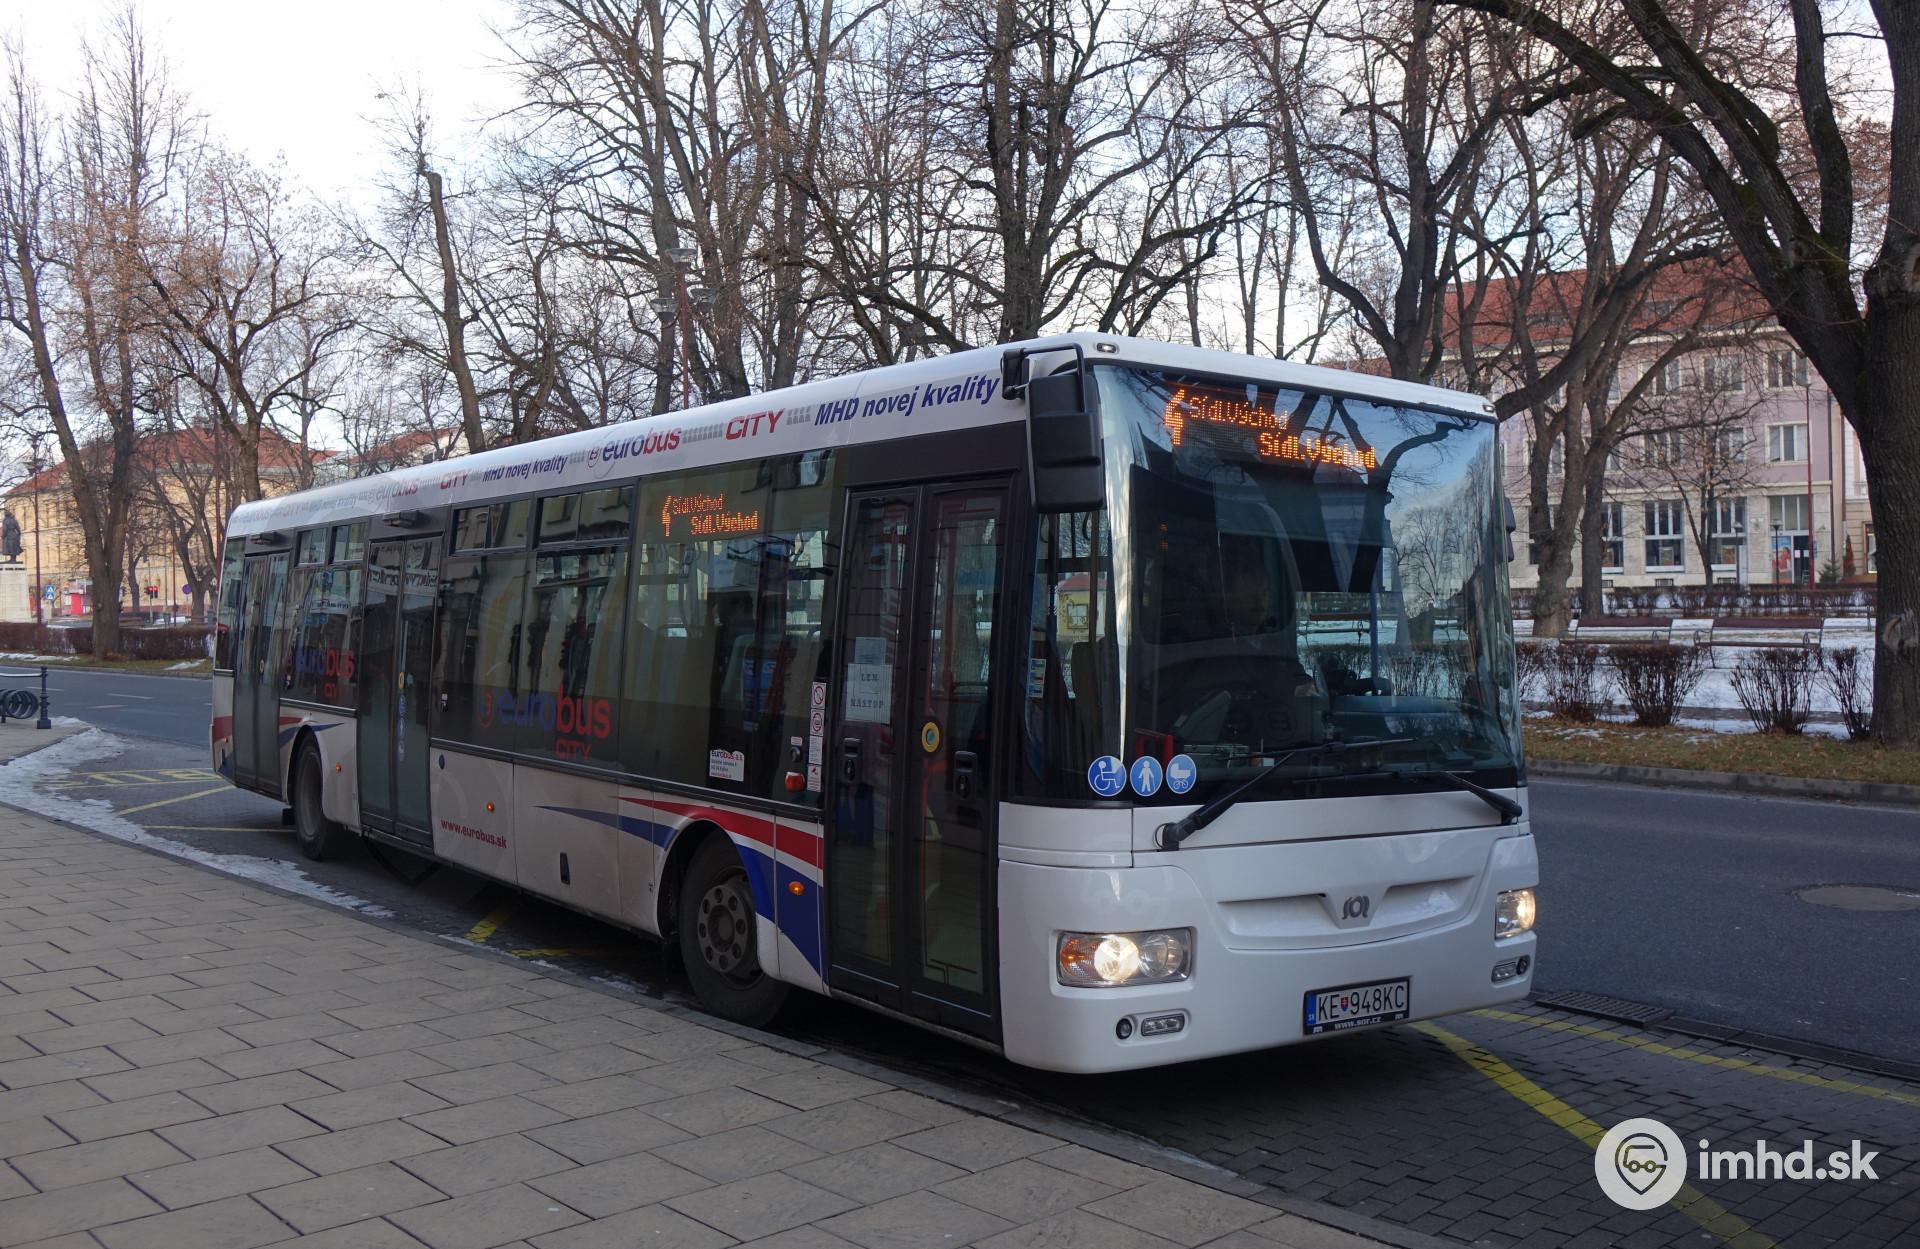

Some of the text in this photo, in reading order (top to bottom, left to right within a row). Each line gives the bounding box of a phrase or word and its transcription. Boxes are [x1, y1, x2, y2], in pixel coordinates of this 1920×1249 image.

[440, 470, 470, 490] CITY
[505, 460, 532, 479] novej
[532, 455, 568, 475] kvality
[602, 428, 682, 462] eurobus
[725, 407, 786, 441] CITY
[814, 397, 860, 426] MHD
[862, 386, 919, 417] novej
[921, 374, 1000, 408] kvality
[1165, 389, 1185, 445] 4
[662, 495, 671, 537] 4
[499, 683, 611, 738] eurobus
[554, 739, 592, 760] CITY
[440, 819, 507, 849] www.eurobus.sk
[1318, 994, 1340, 1022] KE
[1350, 985, 1404, 1016] 948KC
